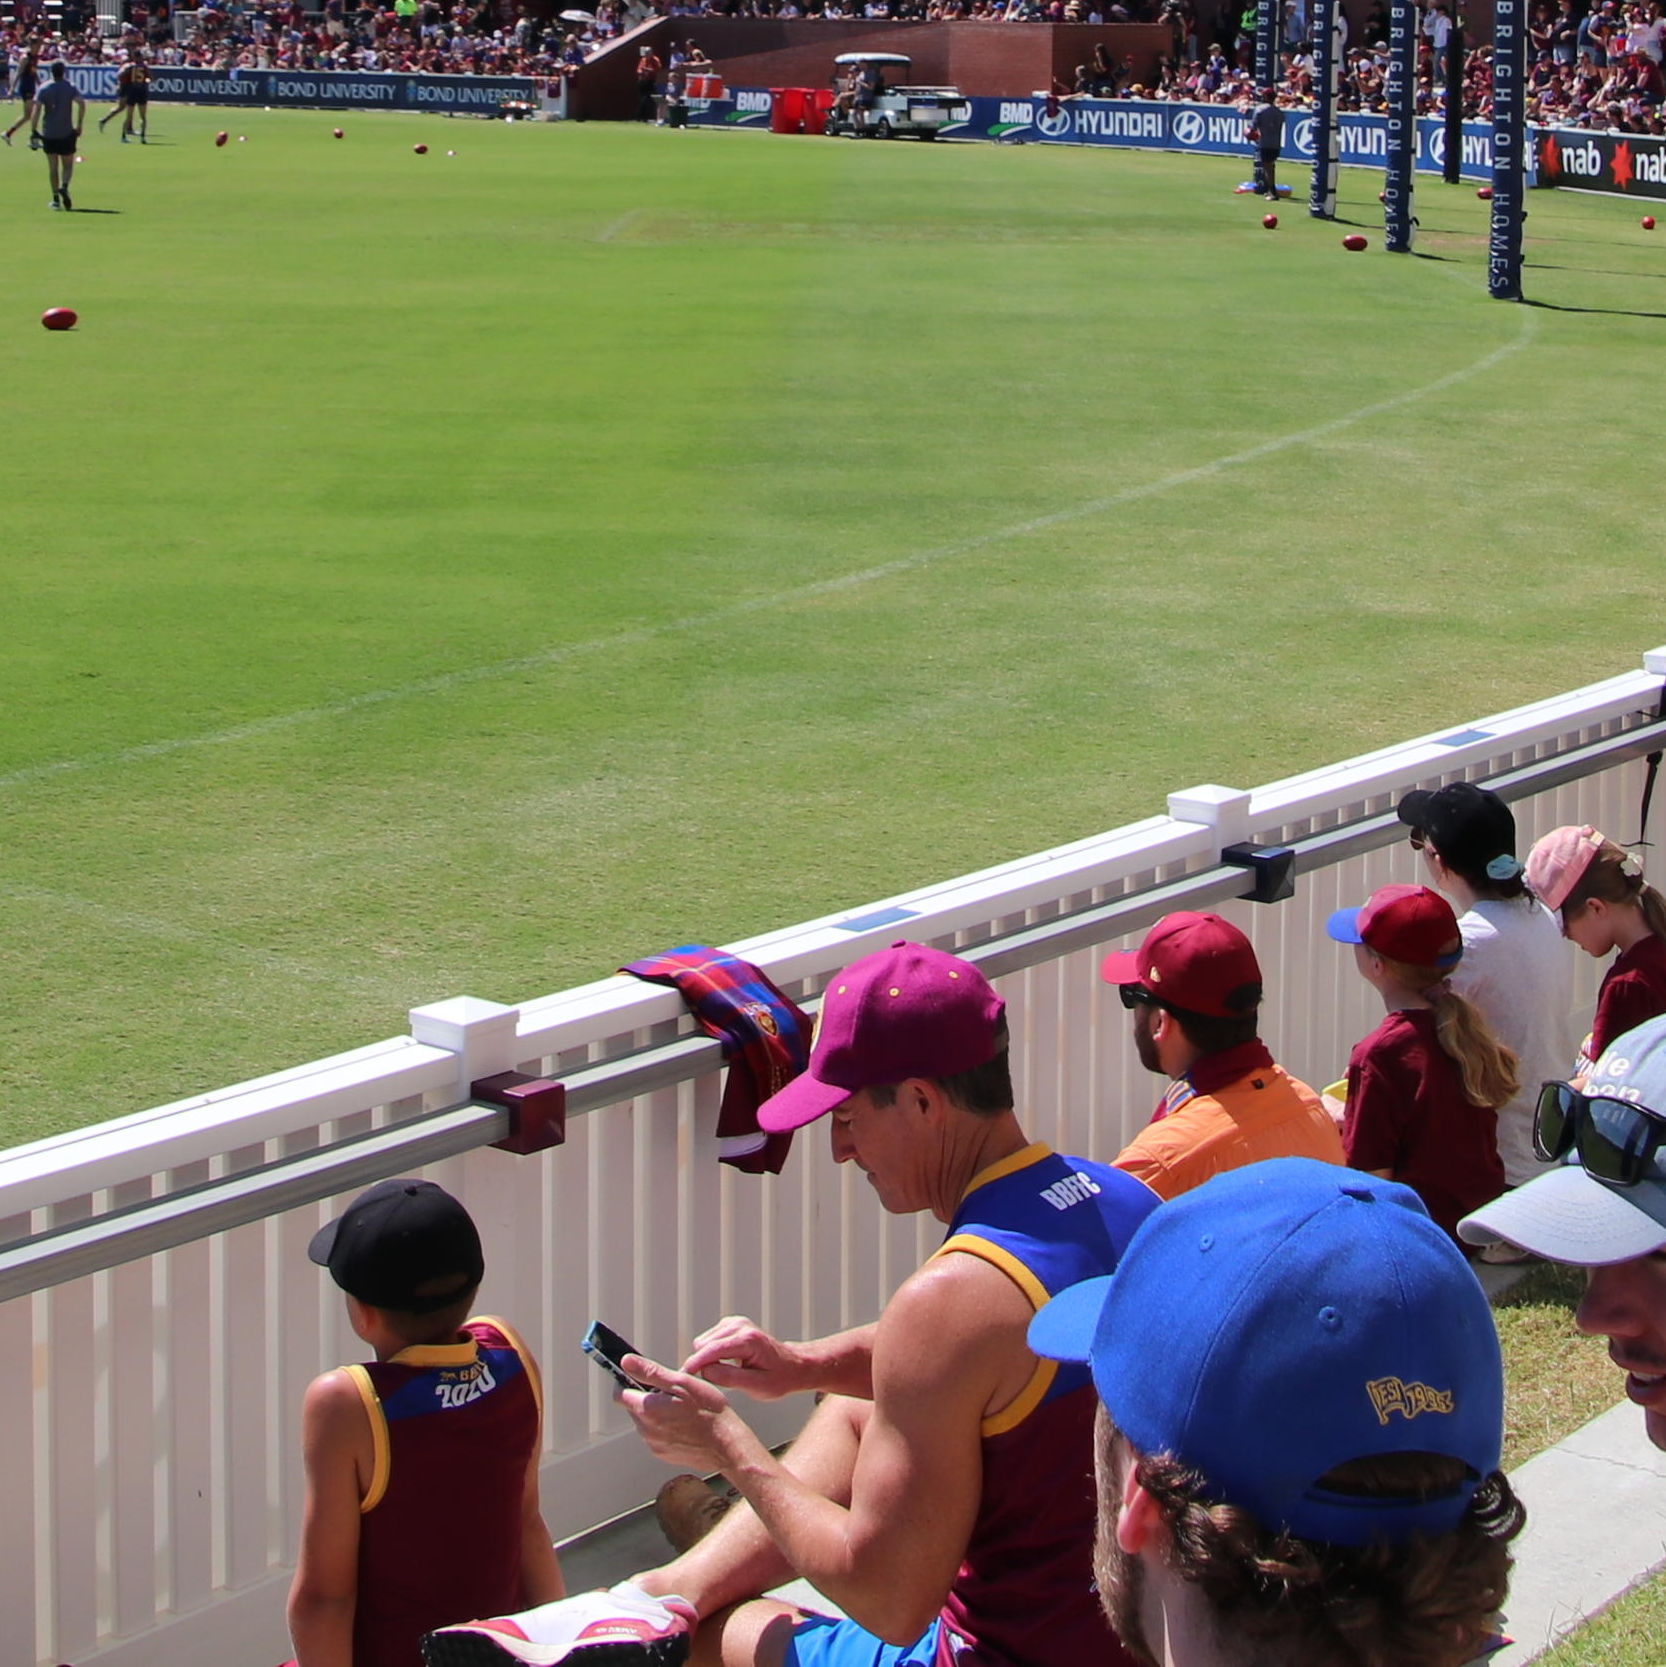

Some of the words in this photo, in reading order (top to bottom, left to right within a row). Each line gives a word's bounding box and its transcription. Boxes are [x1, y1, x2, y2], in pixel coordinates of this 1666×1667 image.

[149, 77, 184, 93] BOND
[187, 79, 260, 96] UNIVERSITY
[278, 81, 317, 98] BOND
[320, 82, 397, 100] UNIVERSITY
[1387, 5, 1406, 152] BRIGHTON
[1494, 0, 1515, 171] BRIGHTON
[417, 85, 456, 103] BOND
[457, 86, 529, 105] UNIVERSITY
[736, 91, 772, 113] BMD
[949, 101, 972, 122] MD
[1000, 101, 1033, 125] BMD
[1074, 108, 1163, 139] HYUNDAI
[1561, 140, 1602, 177] nab
[1490, 192, 1511, 289] HOMES
[1039, 1171, 1102, 1211] BBFFC
[435, 1363, 497, 1409] 2020
